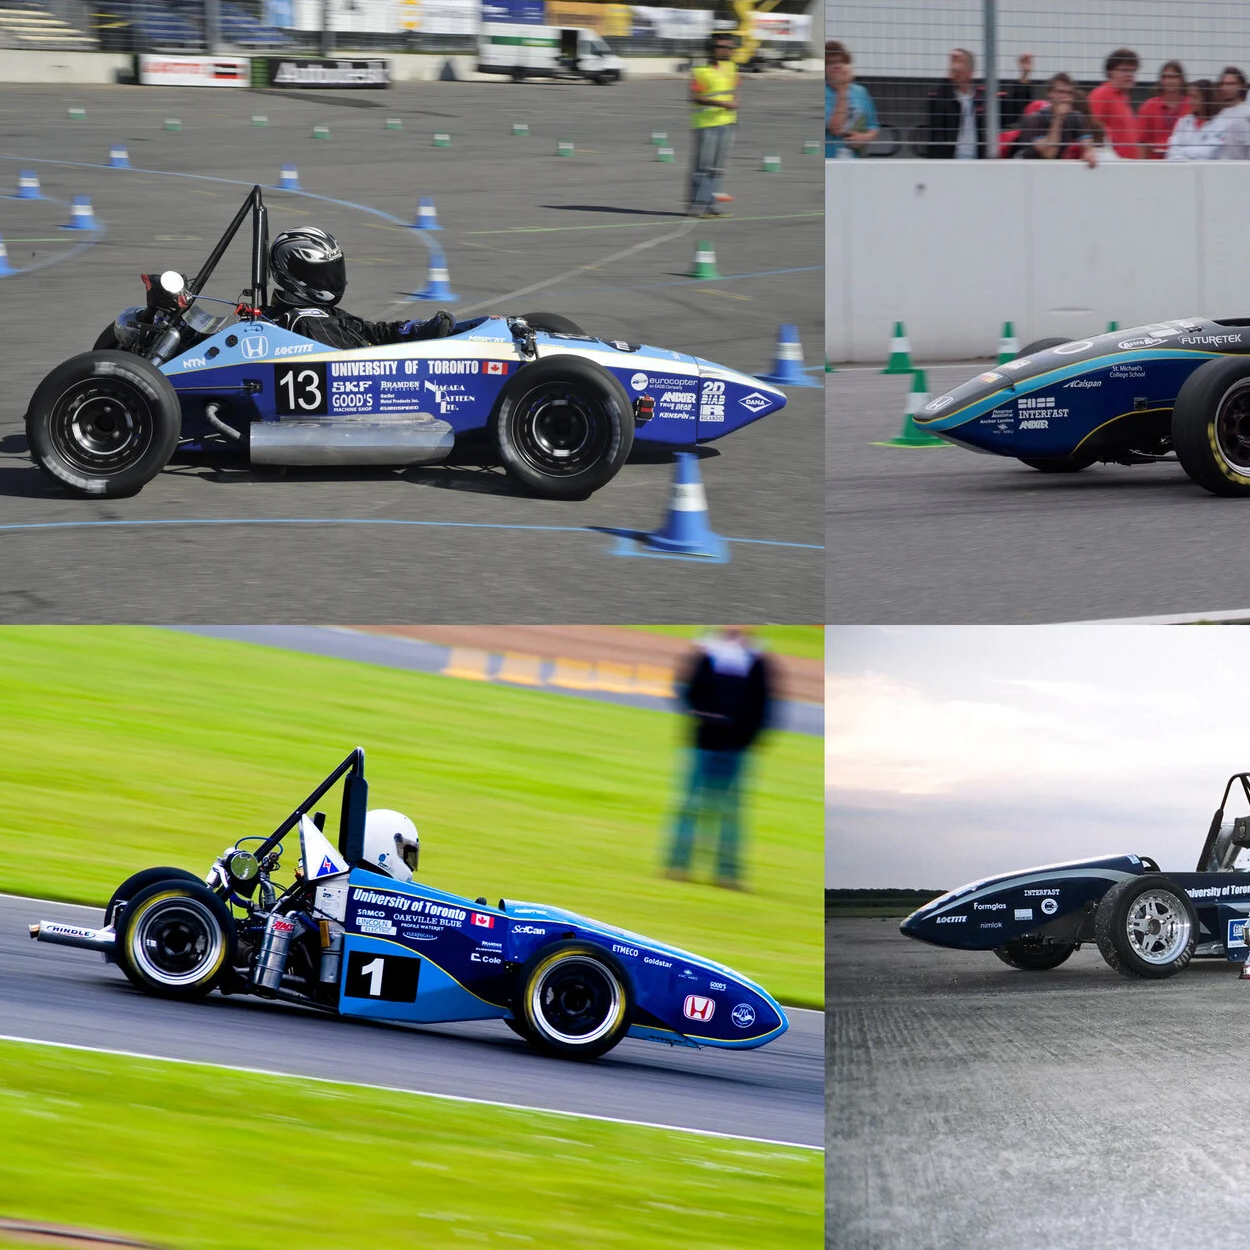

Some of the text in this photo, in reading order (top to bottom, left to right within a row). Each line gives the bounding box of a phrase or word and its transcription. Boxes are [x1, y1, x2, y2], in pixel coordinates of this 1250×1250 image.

[1180, 333, 1242, 347] FUTURETEK
[274, 344, 314, 356] LOCTITE
[182, 357, 206, 369] NTN
[331, 360, 479, 377] UNIVERSITY OF TORONTO
[332, 381, 373, 393] SKF
[424, 379, 465, 393] NIAGARA
[649, 377, 698, 386] eurocopter
[1071, 379, 1102, 389] Calspan
[279, 369, 322, 410] 13
[702, 381, 726, 395] 2D
[332, 394, 373, 408] GOOD'S
[435, 391, 475, 403] PATTERN
[660, 391, 697, 403] ANIXTER
[701, 395, 726, 404] DIAB
[659, 411, 689, 420] KENSPIN
[1018, 408, 1069, 419] INTERFAST
[1023, 888, 1060, 896] INTERFAST
[1222, 886, 1230, 896] of
[352, 888, 467, 921] University of Toronto
[973, 902, 1007, 911] Formglas
[357, 909, 386, 918] SAMCO
[936, 915, 968, 924] LOCTITE
[357, 917, 389, 927] LINCOLN
[393, 913, 462, 928] OAKVILLE BLUE
[980, 921, 1003, 929] nimlok
[51, 925, 93, 938] HINDLE
[511, 924, 546, 936] SciCan
[612, 944, 639, 957] ETMECO
[482, 956, 502, 965] Cole
[643, 956, 673, 968] Goldstar
[361, 957, 385, 997] 1
[709, 981, 727, 989] GOOD'S
